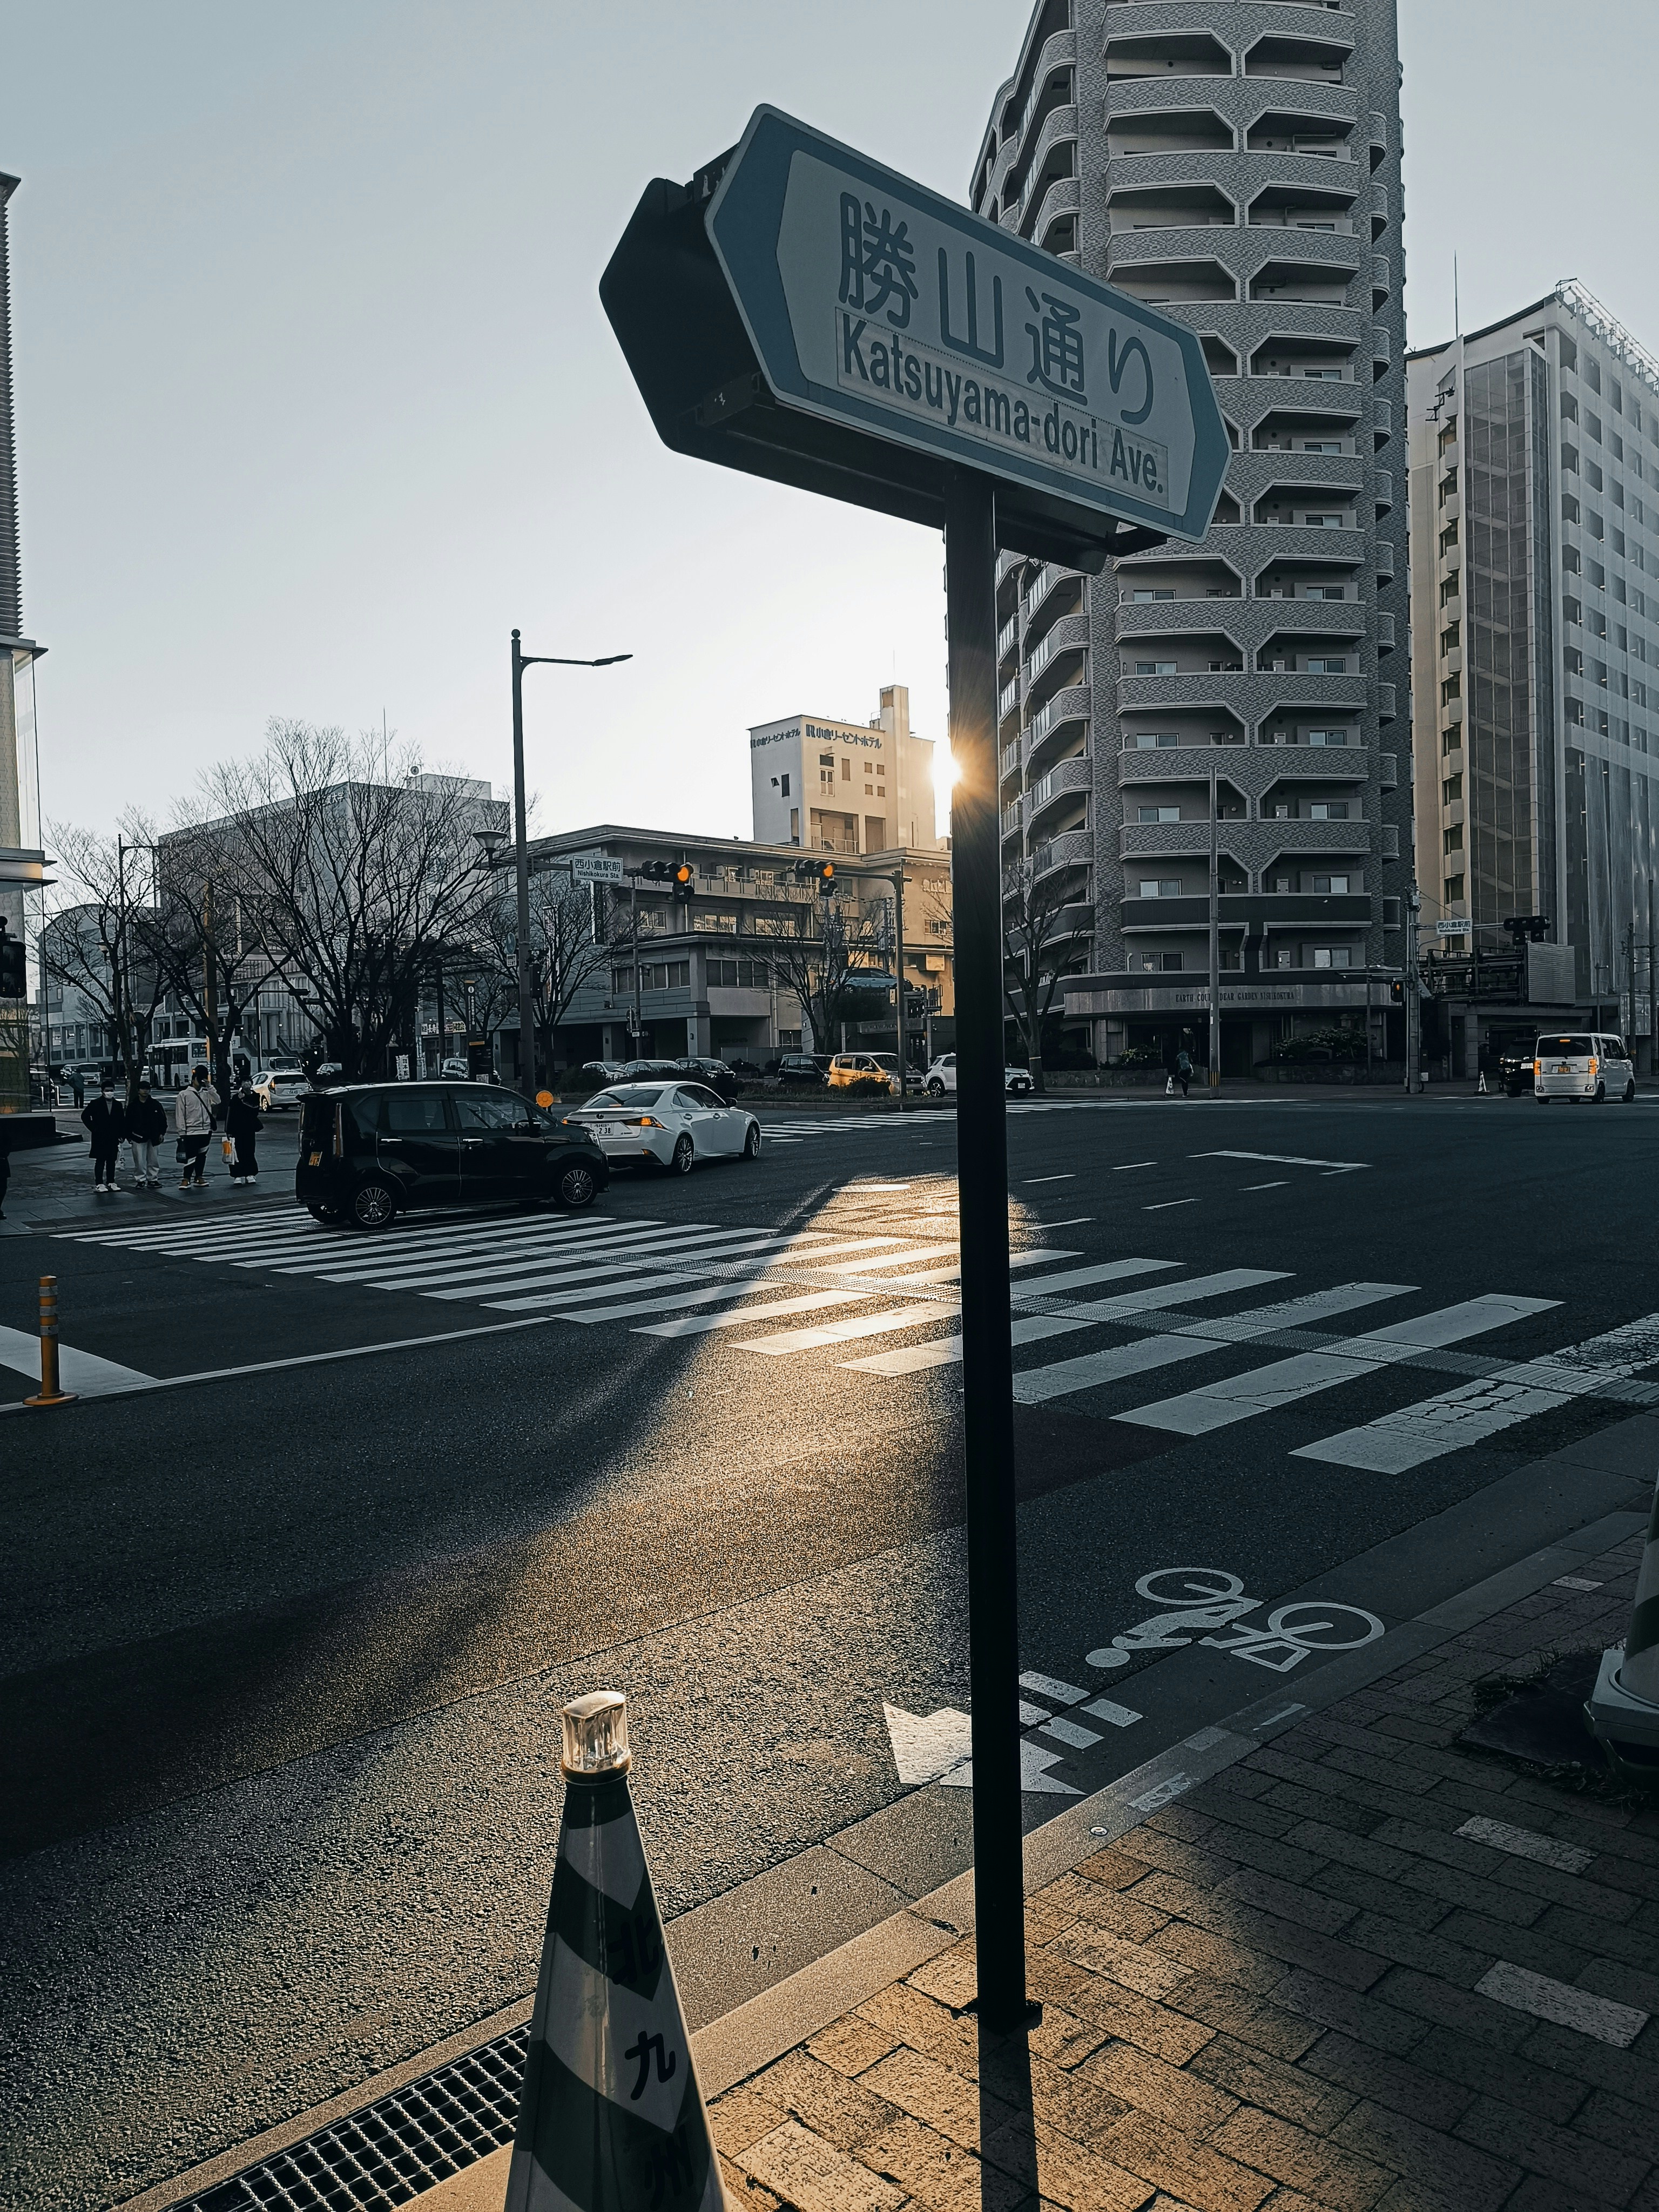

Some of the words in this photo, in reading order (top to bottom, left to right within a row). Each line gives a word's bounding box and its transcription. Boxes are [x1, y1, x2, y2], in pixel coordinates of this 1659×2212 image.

[838, 191, 1154, 425] 勝山通り
[842, 313, 1097, 469] Katsuyama-dori
[1110, 428, 1163, 494] Ave.
[575, 859, 621, 872] 西小倉駅前
[577, 870, 609, 878] Nishikokura
[1176, 994, 1193, 1002] EARTH
[1237, 992, 1258, 1001] GARDEN
[607, 1914, 694, 2212] 北九州
